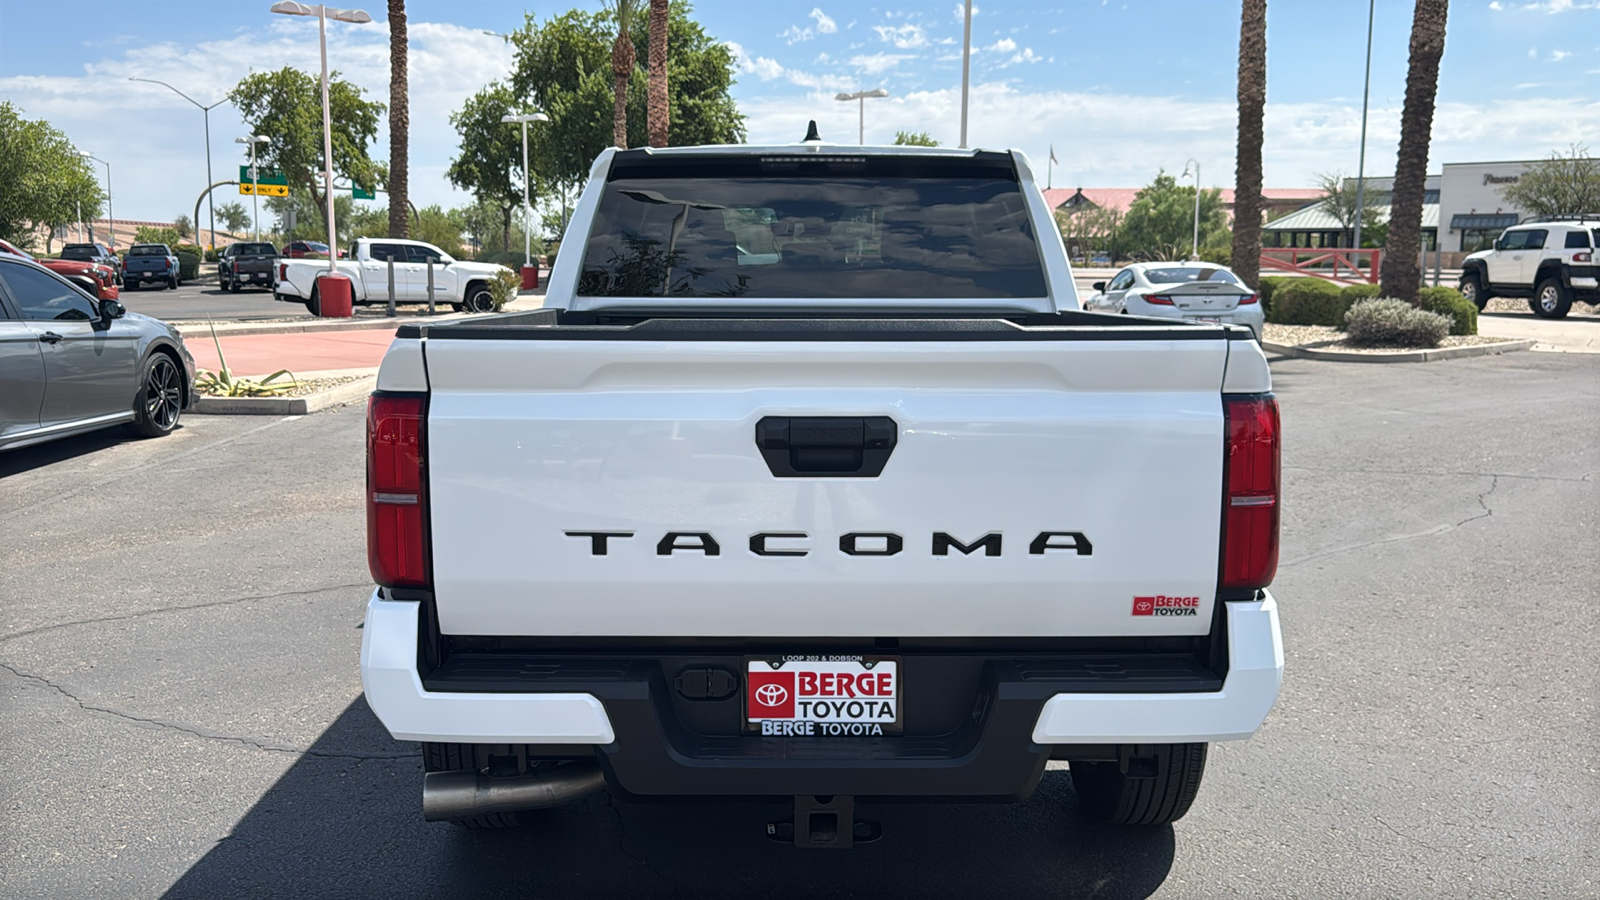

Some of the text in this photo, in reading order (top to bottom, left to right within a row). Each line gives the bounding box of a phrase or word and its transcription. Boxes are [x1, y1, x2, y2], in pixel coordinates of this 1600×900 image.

[795, 428, 861, 439] TOYOTA
[562, 530, 1093, 556] TACOMA
[1155, 595, 1199, 607] BERGE
[1154, 607, 1197, 616] TOYOTA
[798, 671, 893, 698] BERGE
[798, 701, 895, 718] TOYOTA
[761, 720, 883, 737] BERGE TOYOTA
